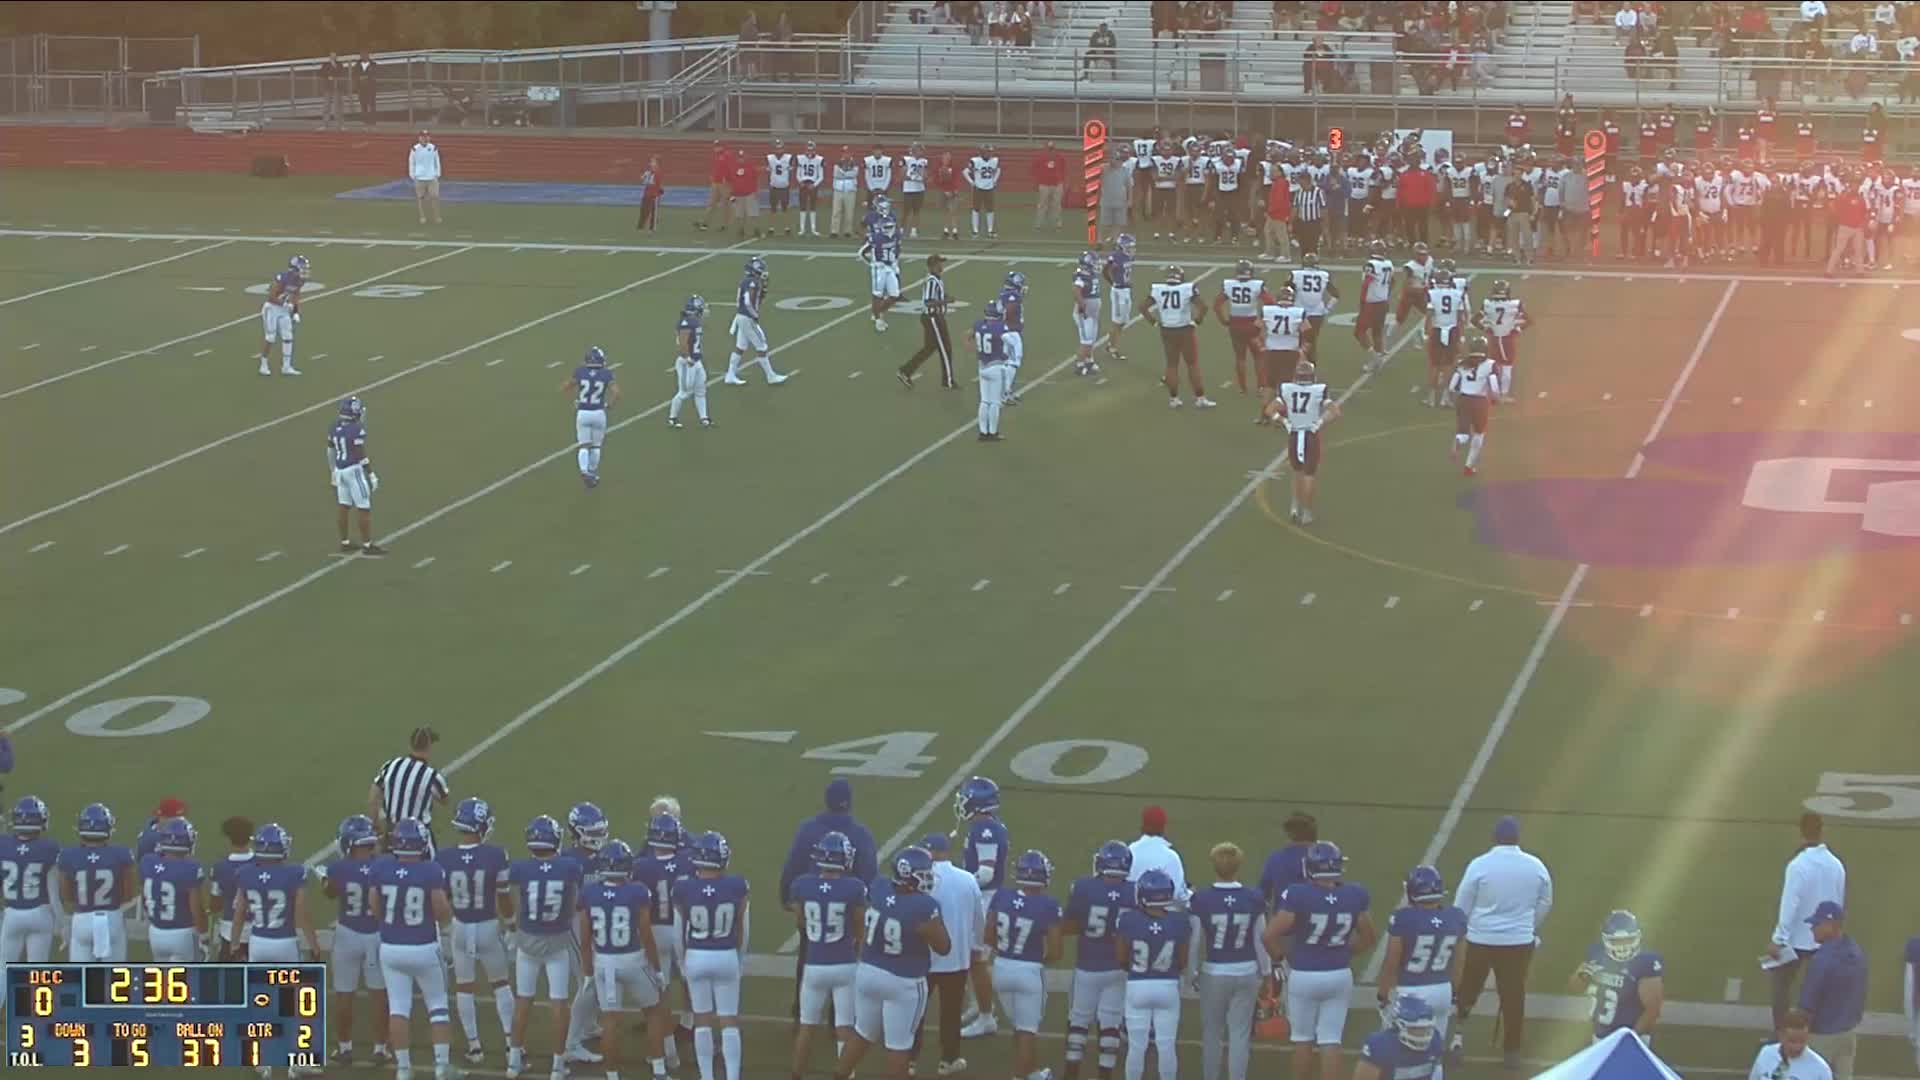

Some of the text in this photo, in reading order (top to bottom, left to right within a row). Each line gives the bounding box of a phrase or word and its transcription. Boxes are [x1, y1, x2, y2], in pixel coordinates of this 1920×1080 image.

[1330, 128, 1343, 149] 3
[1161, 291, 1181, 309] 70
[1232, 287, 1251, 304] 56
[1303, 275, 1322, 293] 53
[1441, 295, 1452, 314] 9
[1496, 307, 1505, 325] 7
[1272, 315, 1291, 335] 71
[580, 379, 605, 403] 22
[1291, 392, 1311, 413] 17
[0, 861, 43, 899] 26
[75, 869, 114, 905] 12
[450, 869, 485, 910] 81
[246, 889, 287, 928] 32
[381, 885, 424, 926] 78
[526, 880, 564, 921] 15
[590, 905, 631, 947] 38
[690, 902, 735, 939] 90
[803, 901, 847, 944] 85
[1211, 913, 1251, 949] 77
[1306, 913, 1352, 946] 72
[1131, 940, 1175, 973] 34
